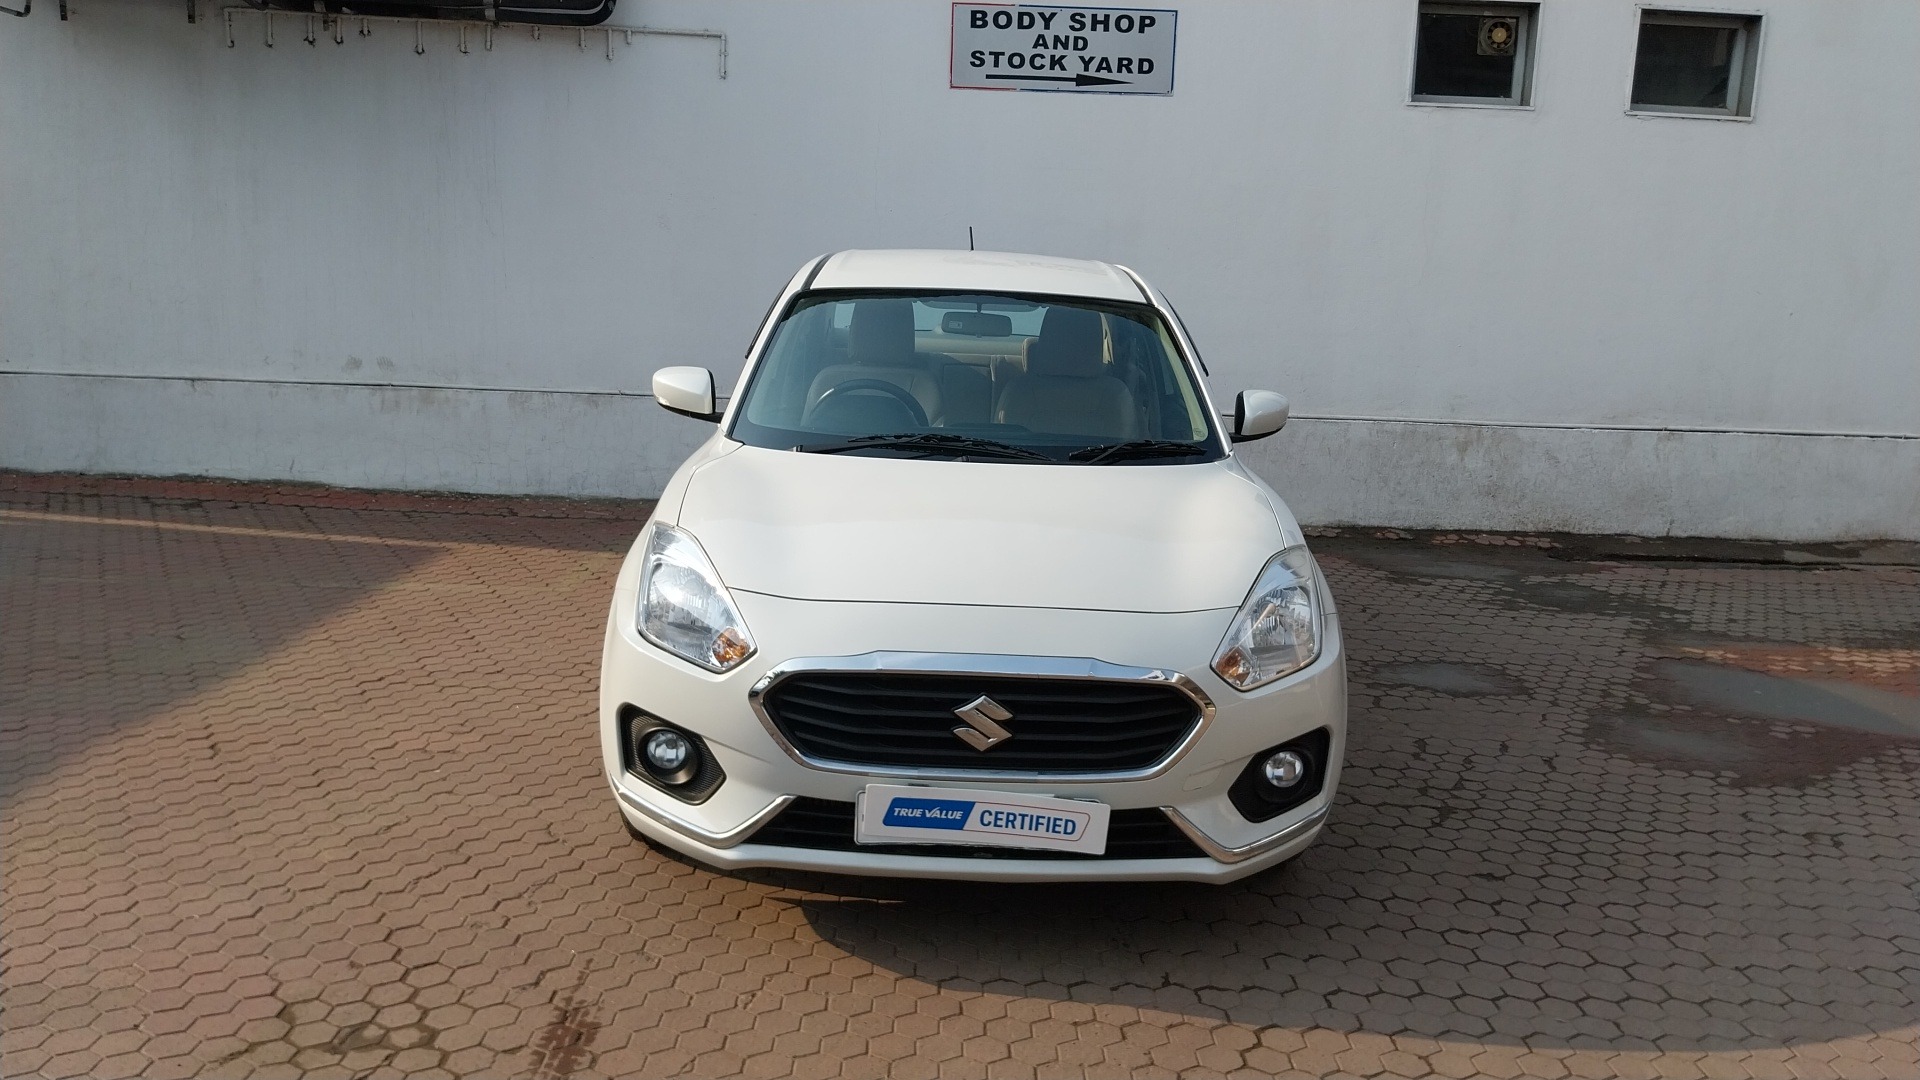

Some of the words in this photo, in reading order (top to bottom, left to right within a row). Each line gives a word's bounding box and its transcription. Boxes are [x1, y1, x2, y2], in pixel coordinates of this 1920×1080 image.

[970, 10, 1057, 30] BODY
[1069, 13, 1156, 34] SHOP
[1032, 34, 1089, 51] AND
[970, 50, 1068, 71] STOCK
[1078, 55, 1155, 75] YARD
[893, 807, 923, 817] TRUE
[925, 807, 963, 819] VALUE
[979, 809, 1077, 836] CERTIFIED
